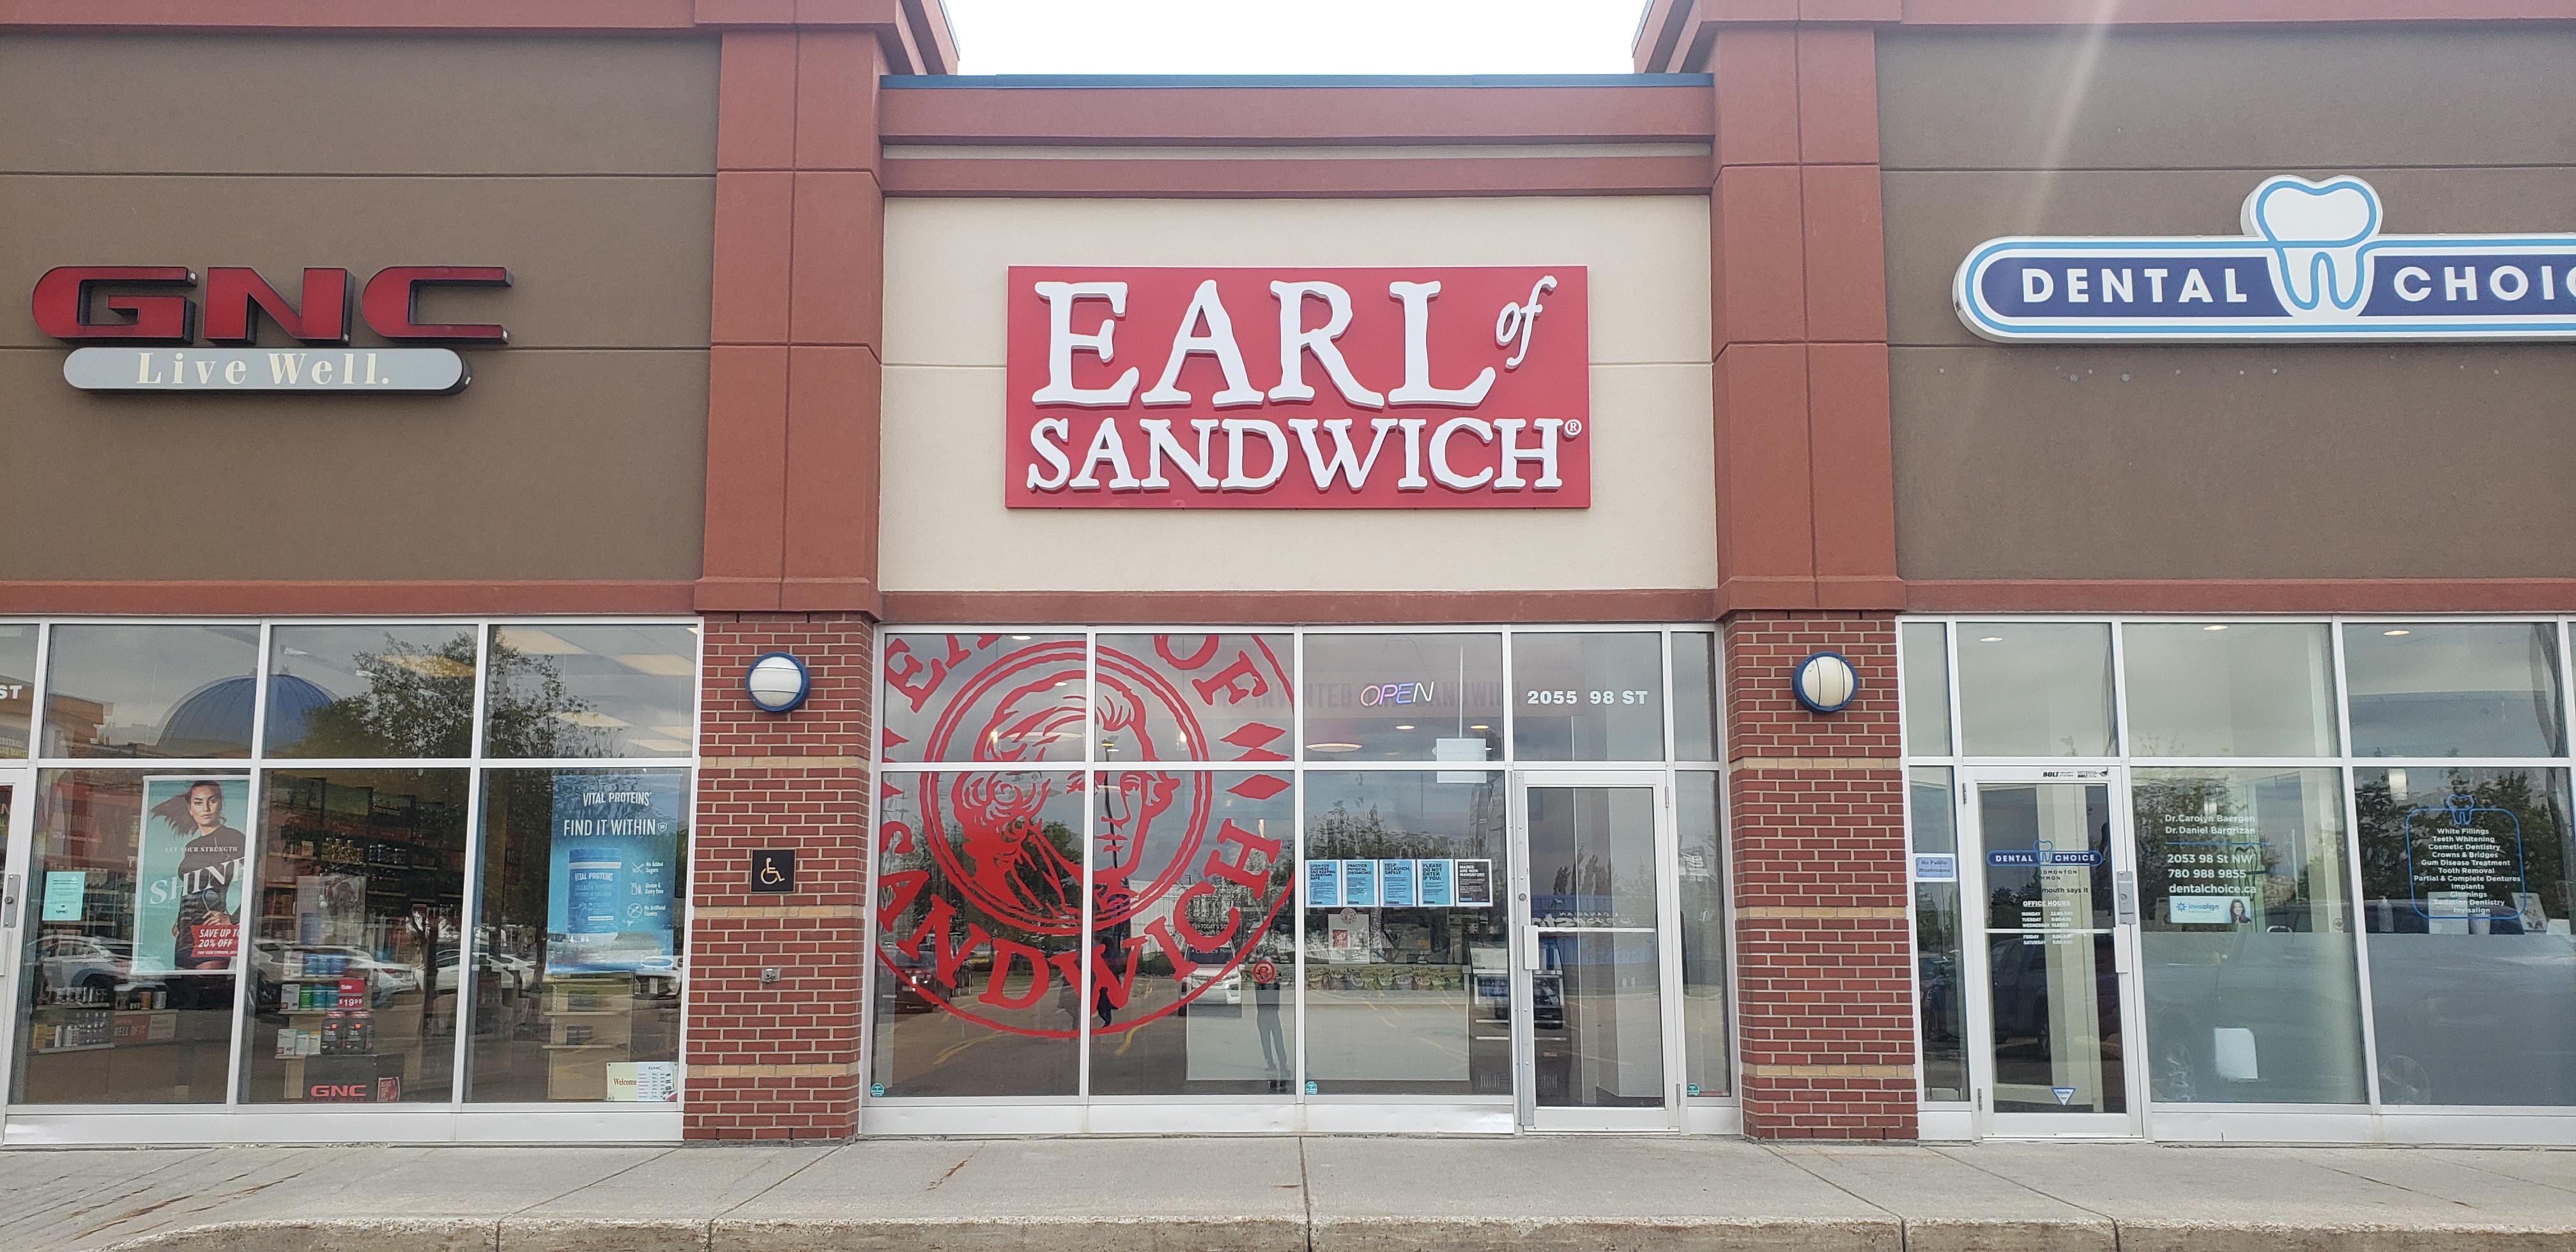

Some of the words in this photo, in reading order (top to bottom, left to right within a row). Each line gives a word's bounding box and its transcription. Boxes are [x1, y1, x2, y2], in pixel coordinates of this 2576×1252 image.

[2021, 268, 2247, 303] DENTAL
[2394, 266, 2576, 303] CHOI
[32, 266, 511, 344] GNC
[1032, 279, 1496, 408] EARL
[1496, 275, 1558, 370] of
[136, 353, 247, 385] Live
[268, 353, 390, 385] Well.
[0, 685, 22, 699] ST
[1360, 681, 1434, 706] OPEN
[1527, 690, 1577, 705] 2055
[1590, 690, 1614, 705] 98
[1622, 690, 1648, 705] ST
[583, 792, 606, 807] VITAL
[609, 792, 650, 806] PROTEINS
[564, 819, 592, 836] FIND
[597, 819, 607, 836] IT
[611, 819, 656, 836] WITHIN
[2211, 827, 2255, 835] Bargrizan
[2167, 854, 2195, 863] 2053
[2200, 854, 2213, 863] 98
[2216, 854, 2228, 863] St
[2232, 854, 2253, 863] NW
[575, 873, 587, 882] VITAL
[588, 873, 613, 882] PROTEINS
[2168, 869, 2189, 878] 780
[2193, 869, 2214, 878] 988
[2219, 869, 2246, 878] 9855
[2169, 884, 2257, 893] dentalchoice.ca
[199, 929, 218, 938] SAVE
[220, 929, 231, 938] UP
[198, 939, 215, 948] 20%
[218, 939, 233, 948] OFF
[613, 1078, 637, 1086] Welcome
[310, 1085, 367, 1097] GNC
